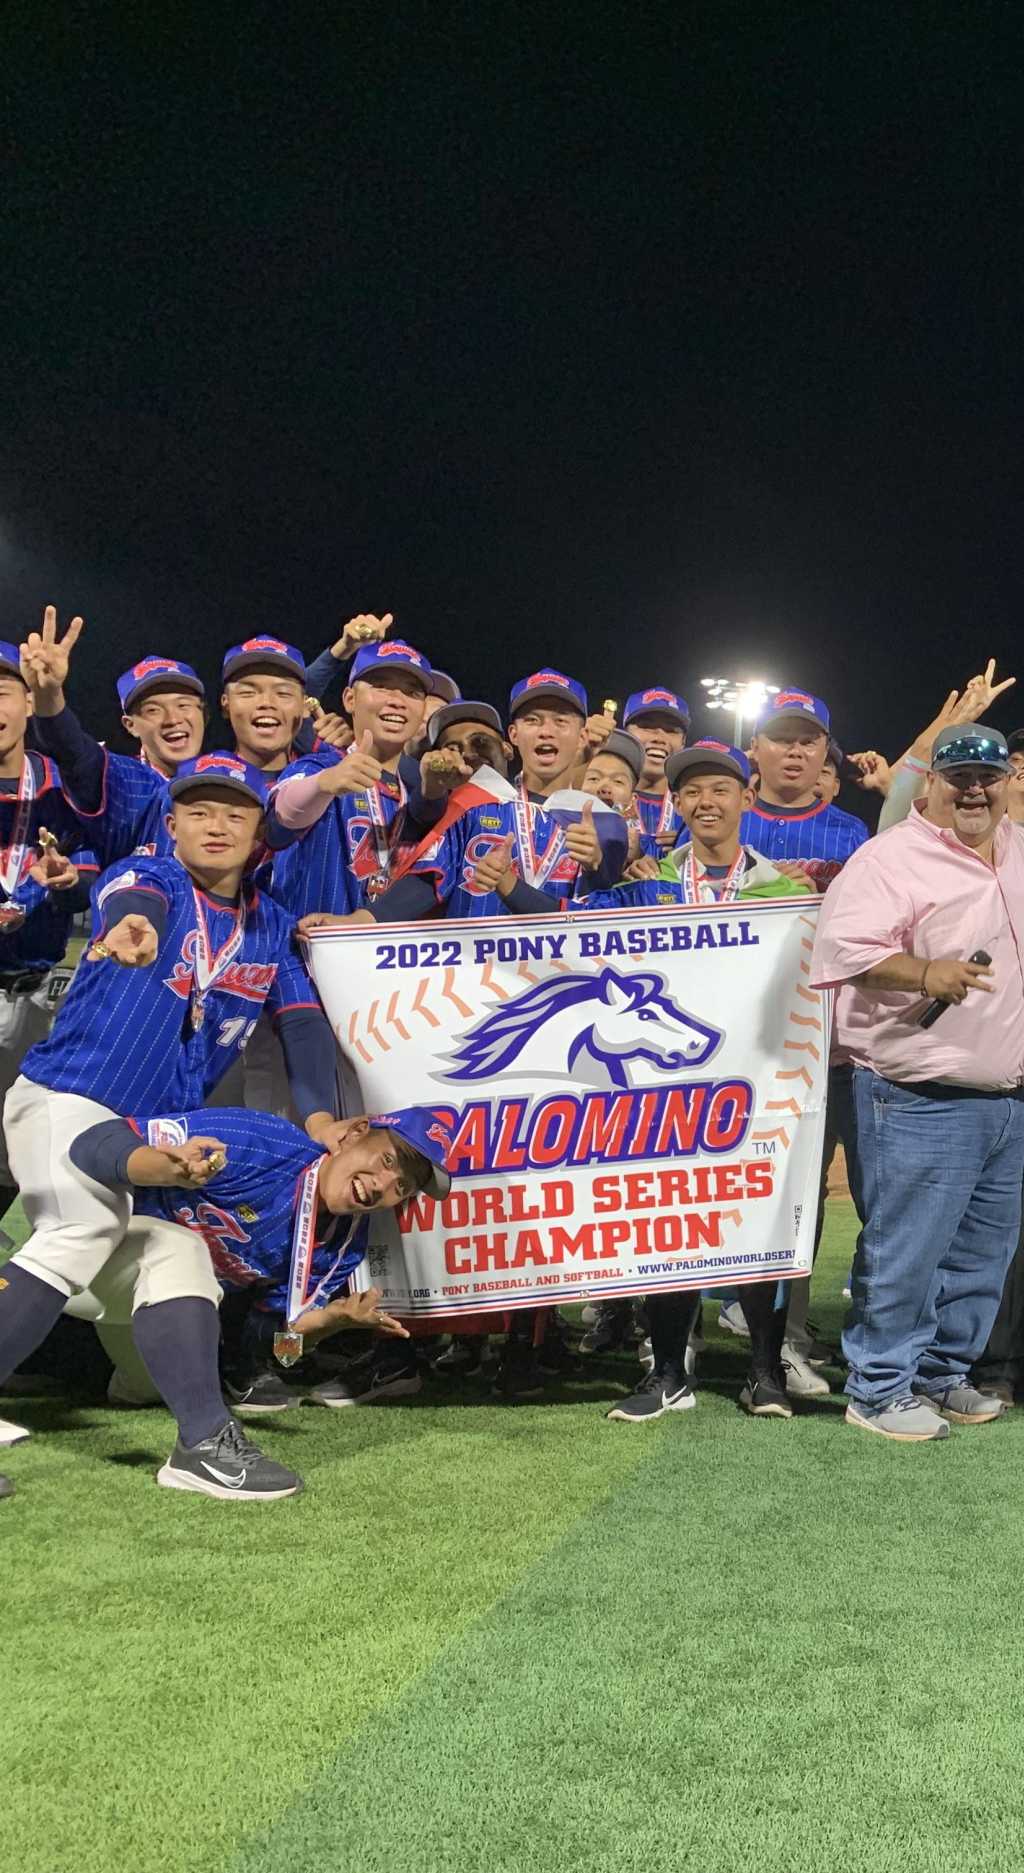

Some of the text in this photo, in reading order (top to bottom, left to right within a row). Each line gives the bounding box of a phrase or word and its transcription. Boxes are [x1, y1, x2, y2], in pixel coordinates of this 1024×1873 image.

[376, 921, 760, 970] 2022 PONY BASEBALL
[752, 1141, 776, 1155] TM
[394, 1161, 774, 1234] WORLD SERIES
[444, 1211, 722, 1276] CHAMPION
[442, 1285, 470, 1297] PONY
[473, 1278, 532, 1293] BASEBALL
[536, 1274, 560, 1286] AND
[564, 1268, 623, 1283] SOFTBALL
